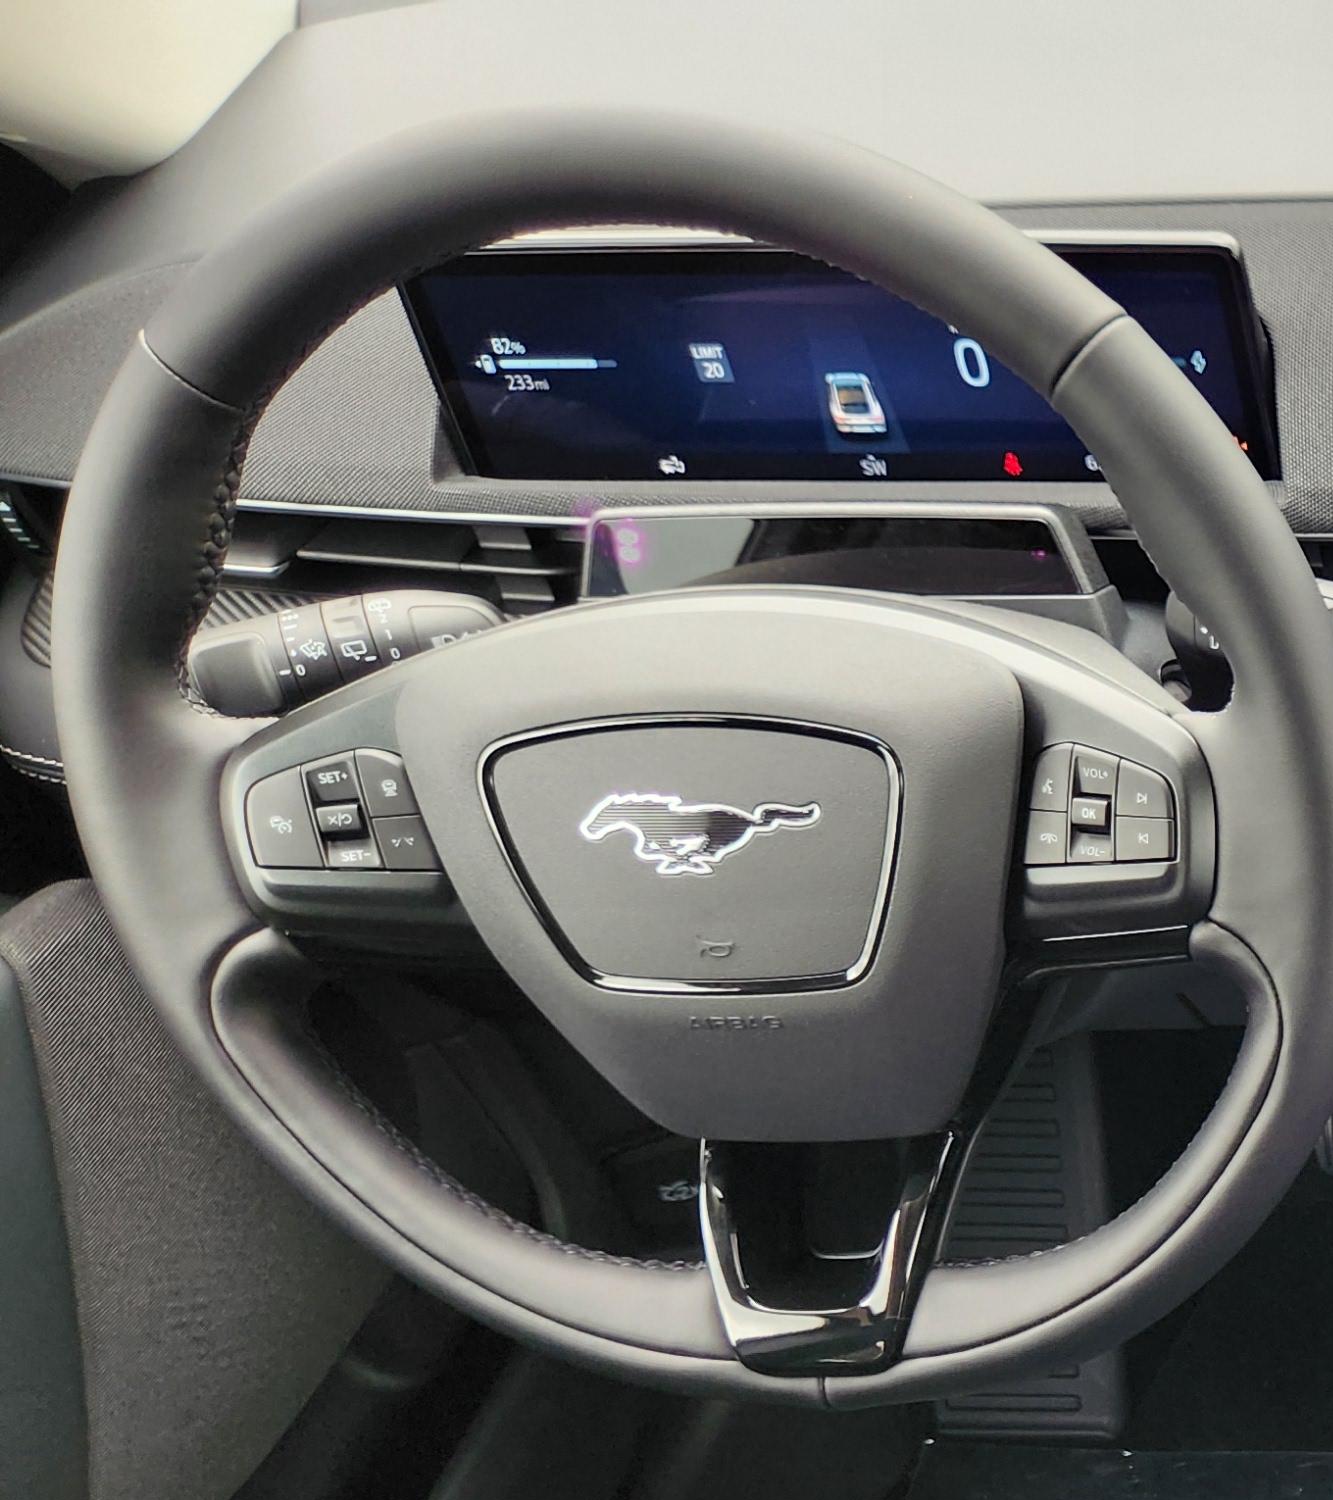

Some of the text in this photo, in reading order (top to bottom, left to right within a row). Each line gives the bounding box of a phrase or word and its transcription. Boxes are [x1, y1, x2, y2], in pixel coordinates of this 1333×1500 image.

[490, 338, 526, 355] 82%
[690, 346, 723, 360] LIMIT
[953, 337, 991, 388] 0
[702, 363, 725, 379] 20
[859, 458, 888, 477] SW
[1081, 808, 1097, 820] OK
[689, 1015, 783, 1031] AIRBAG
